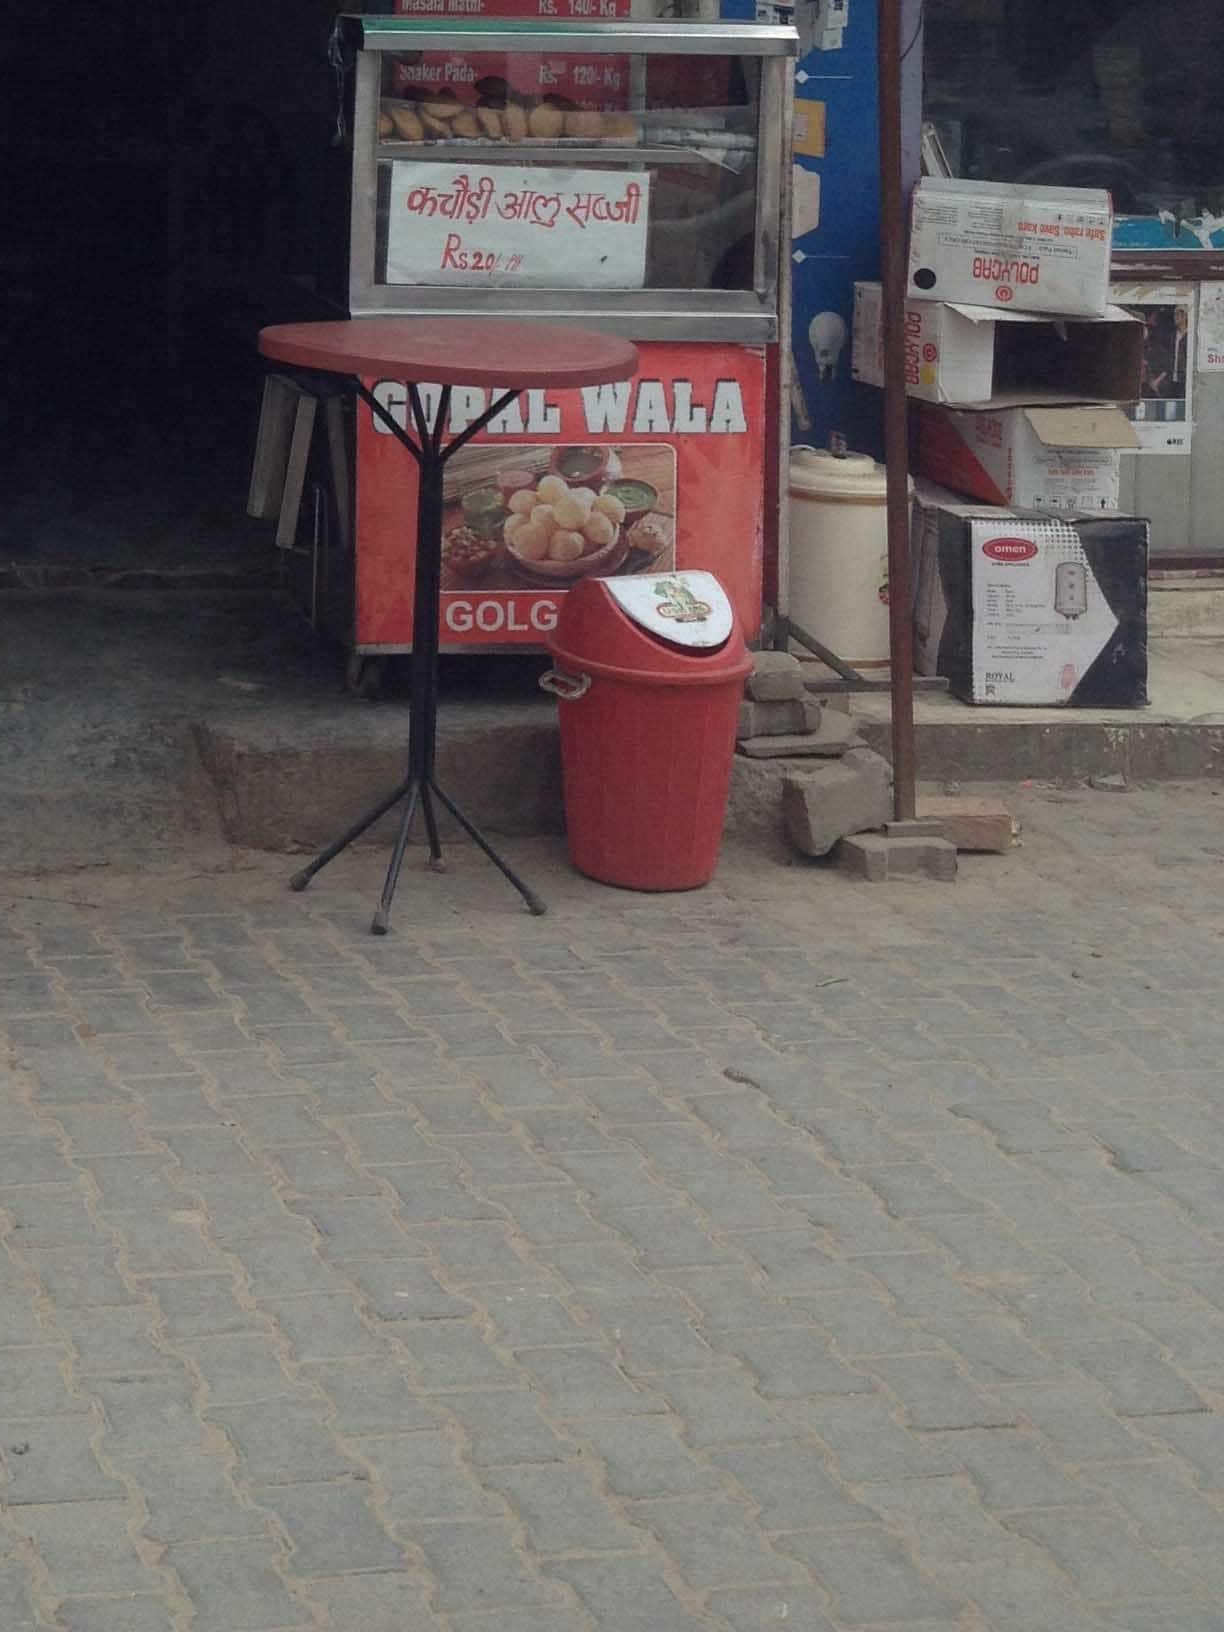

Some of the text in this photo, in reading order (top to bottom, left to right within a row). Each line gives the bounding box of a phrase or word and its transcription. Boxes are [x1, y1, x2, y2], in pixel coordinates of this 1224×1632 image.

[972, 256, 1040, 284] POLYCAB
[371, 378, 748, 435] GOPAL WALA
